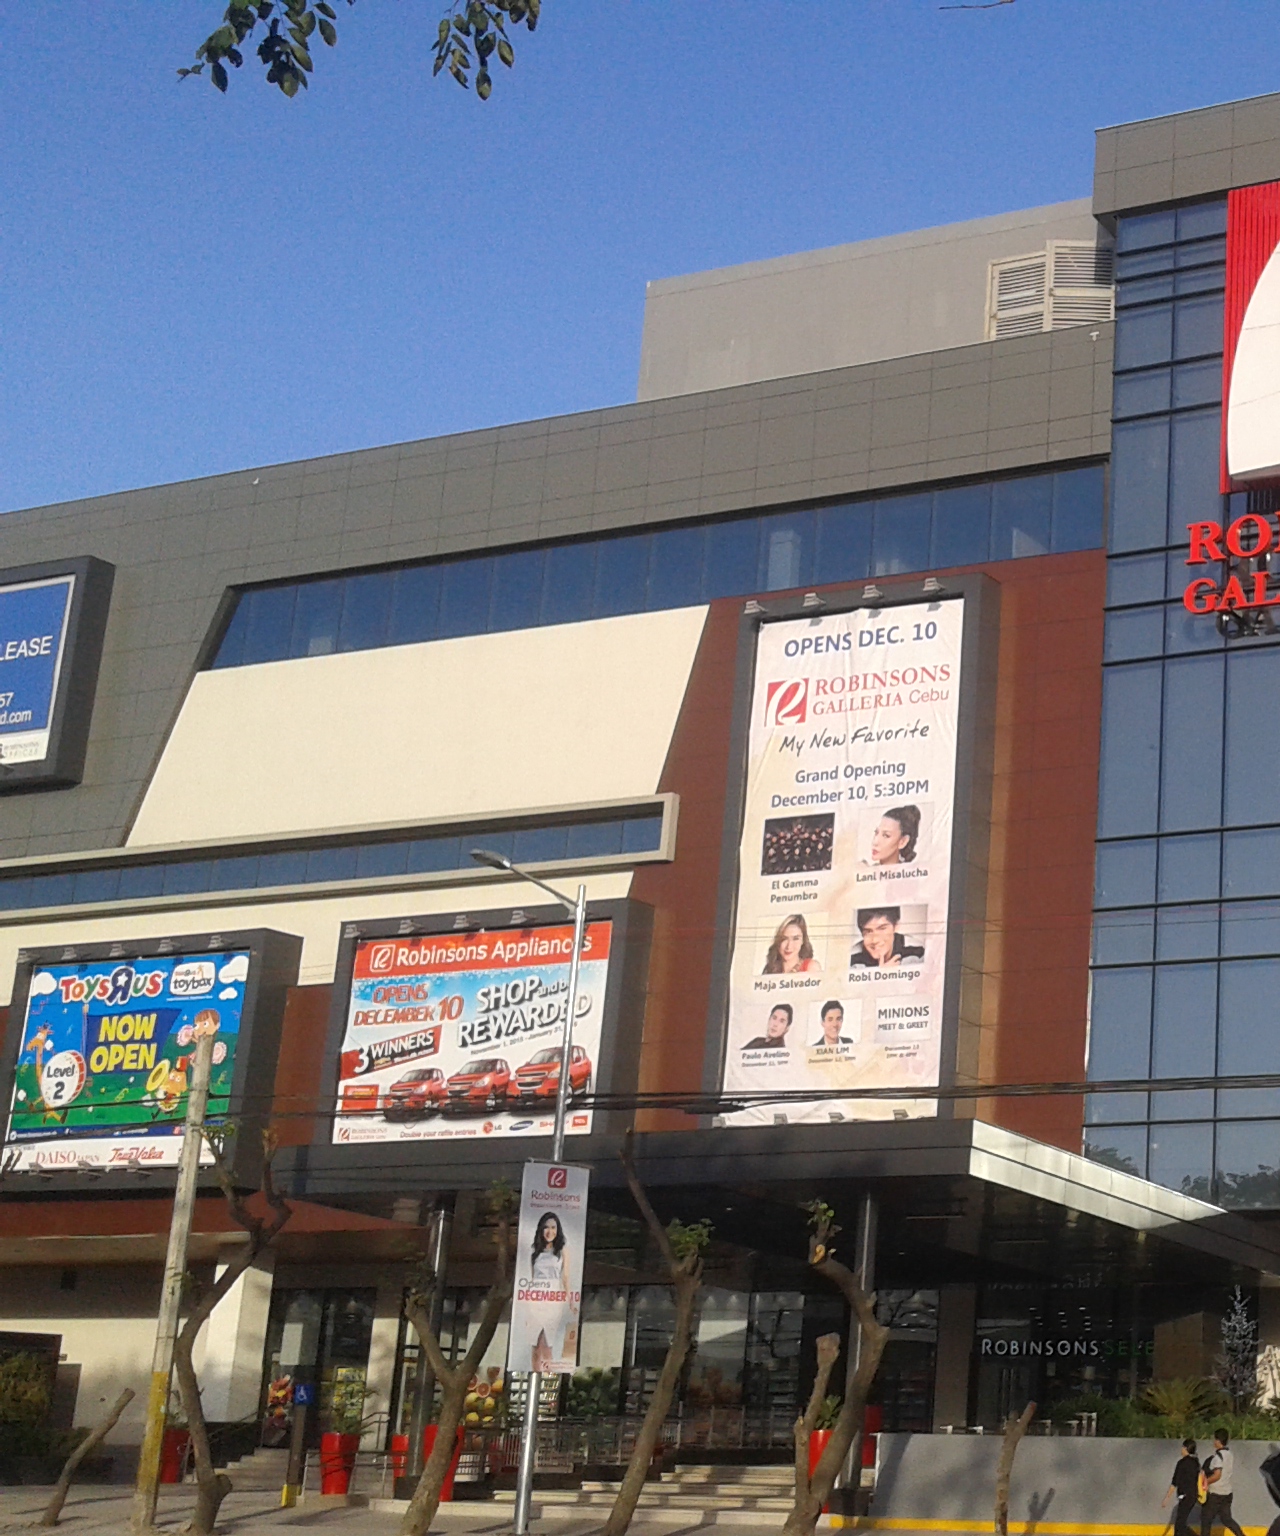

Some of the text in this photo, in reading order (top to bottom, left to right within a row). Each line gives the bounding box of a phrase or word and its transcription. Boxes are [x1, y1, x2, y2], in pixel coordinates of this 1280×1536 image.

[784, 621, 937, 657] OPENS DEC. 10
[815, 664, 951, 697] ROBINSONS
[812, 687, 950, 716] GALLERIA Cebu
[779, 717, 931, 758] My New Favorite
[795, 760, 907, 784] Grand Opening
[771, 788, 844, 808] December
[874, 779, 930, 799] 5:30PM
[771, 877, 819, 890] El Gamma
[856, 867, 929, 883] Lani Misalucha
[770, 891, 819, 903] Penumbra
[397, 943, 488, 967] Robinsons
[491, 936, 593, 963] Appliancs
[754, 977, 821, 991] Maja Salvador
[849, 969, 921, 983] Robi Domingo
[373, 983, 429, 1004] OPENS
[476, 974, 543, 1013] SHOP
[353, 995, 465, 1026] DECEMBER 10
[878, 1005, 930, 1019] MINIONS
[98, 1013, 158, 1042] NOW
[877, 1022, 896, 1030] MEET
[906, 1021, 928, 1029] GREET
[89, 1043, 158, 1074] OPEN
[353, 1045, 370, 1073] 3
[369, 1029, 435, 1060] WINNERS
[46, 1063, 76, 1079] Level
[53, 1081, 65, 1100] 2
[35, 1150, 77, 1164] DAISO
[531, 1189, 581, 1203] Robinsons
[518, 1277, 551, 1289] Opens
[517, 1289, 580, 1302] DECEMBER 10
[981, 1338, 1099, 1356] ROBINSONS
